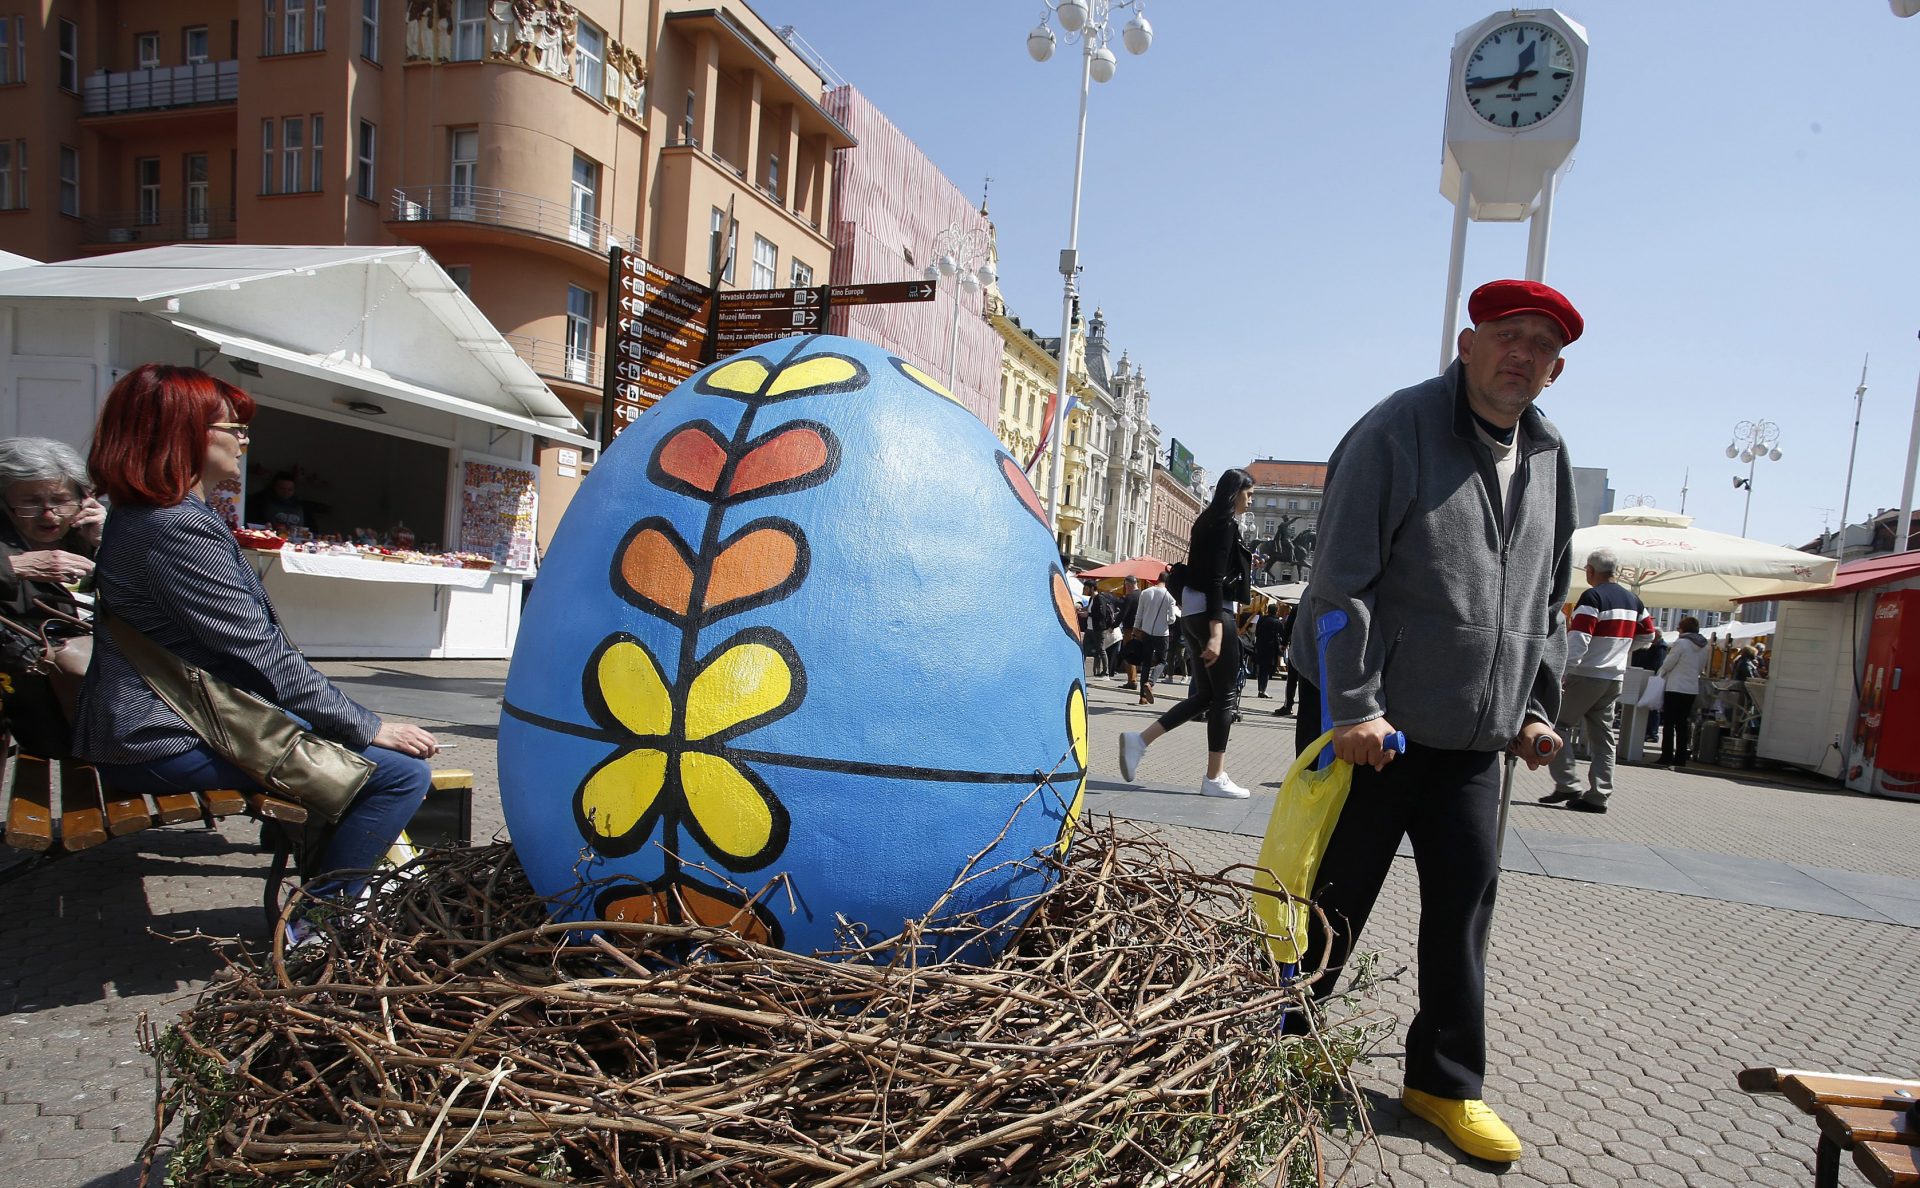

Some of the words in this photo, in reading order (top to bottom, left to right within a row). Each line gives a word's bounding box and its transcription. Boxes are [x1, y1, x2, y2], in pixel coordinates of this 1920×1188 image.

[646, 263, 664, 278] Muzej
[645, 283, 668, 299] Galerija
[720, 292, 745, 301] Hrvatski
[745, 291, 769, 300] državni
[769, 291, 786, 299] arhiv
[831, 288, 844, 296] Kino
[844, 287, 865, 296] Europa
[719, 313, 738, 321] Muzej
[737, 312, 762, 320] Mimara
[717, 333, 735, 341] Muzej
[743, 332, 774, 341] umjetnost
[642, 345, 666, 360] Hrvatski
[666, 355, 690, 369] povijesni
[641, 367, 658, 379] Crkva
[658, 372, 667, 382] Sv.
